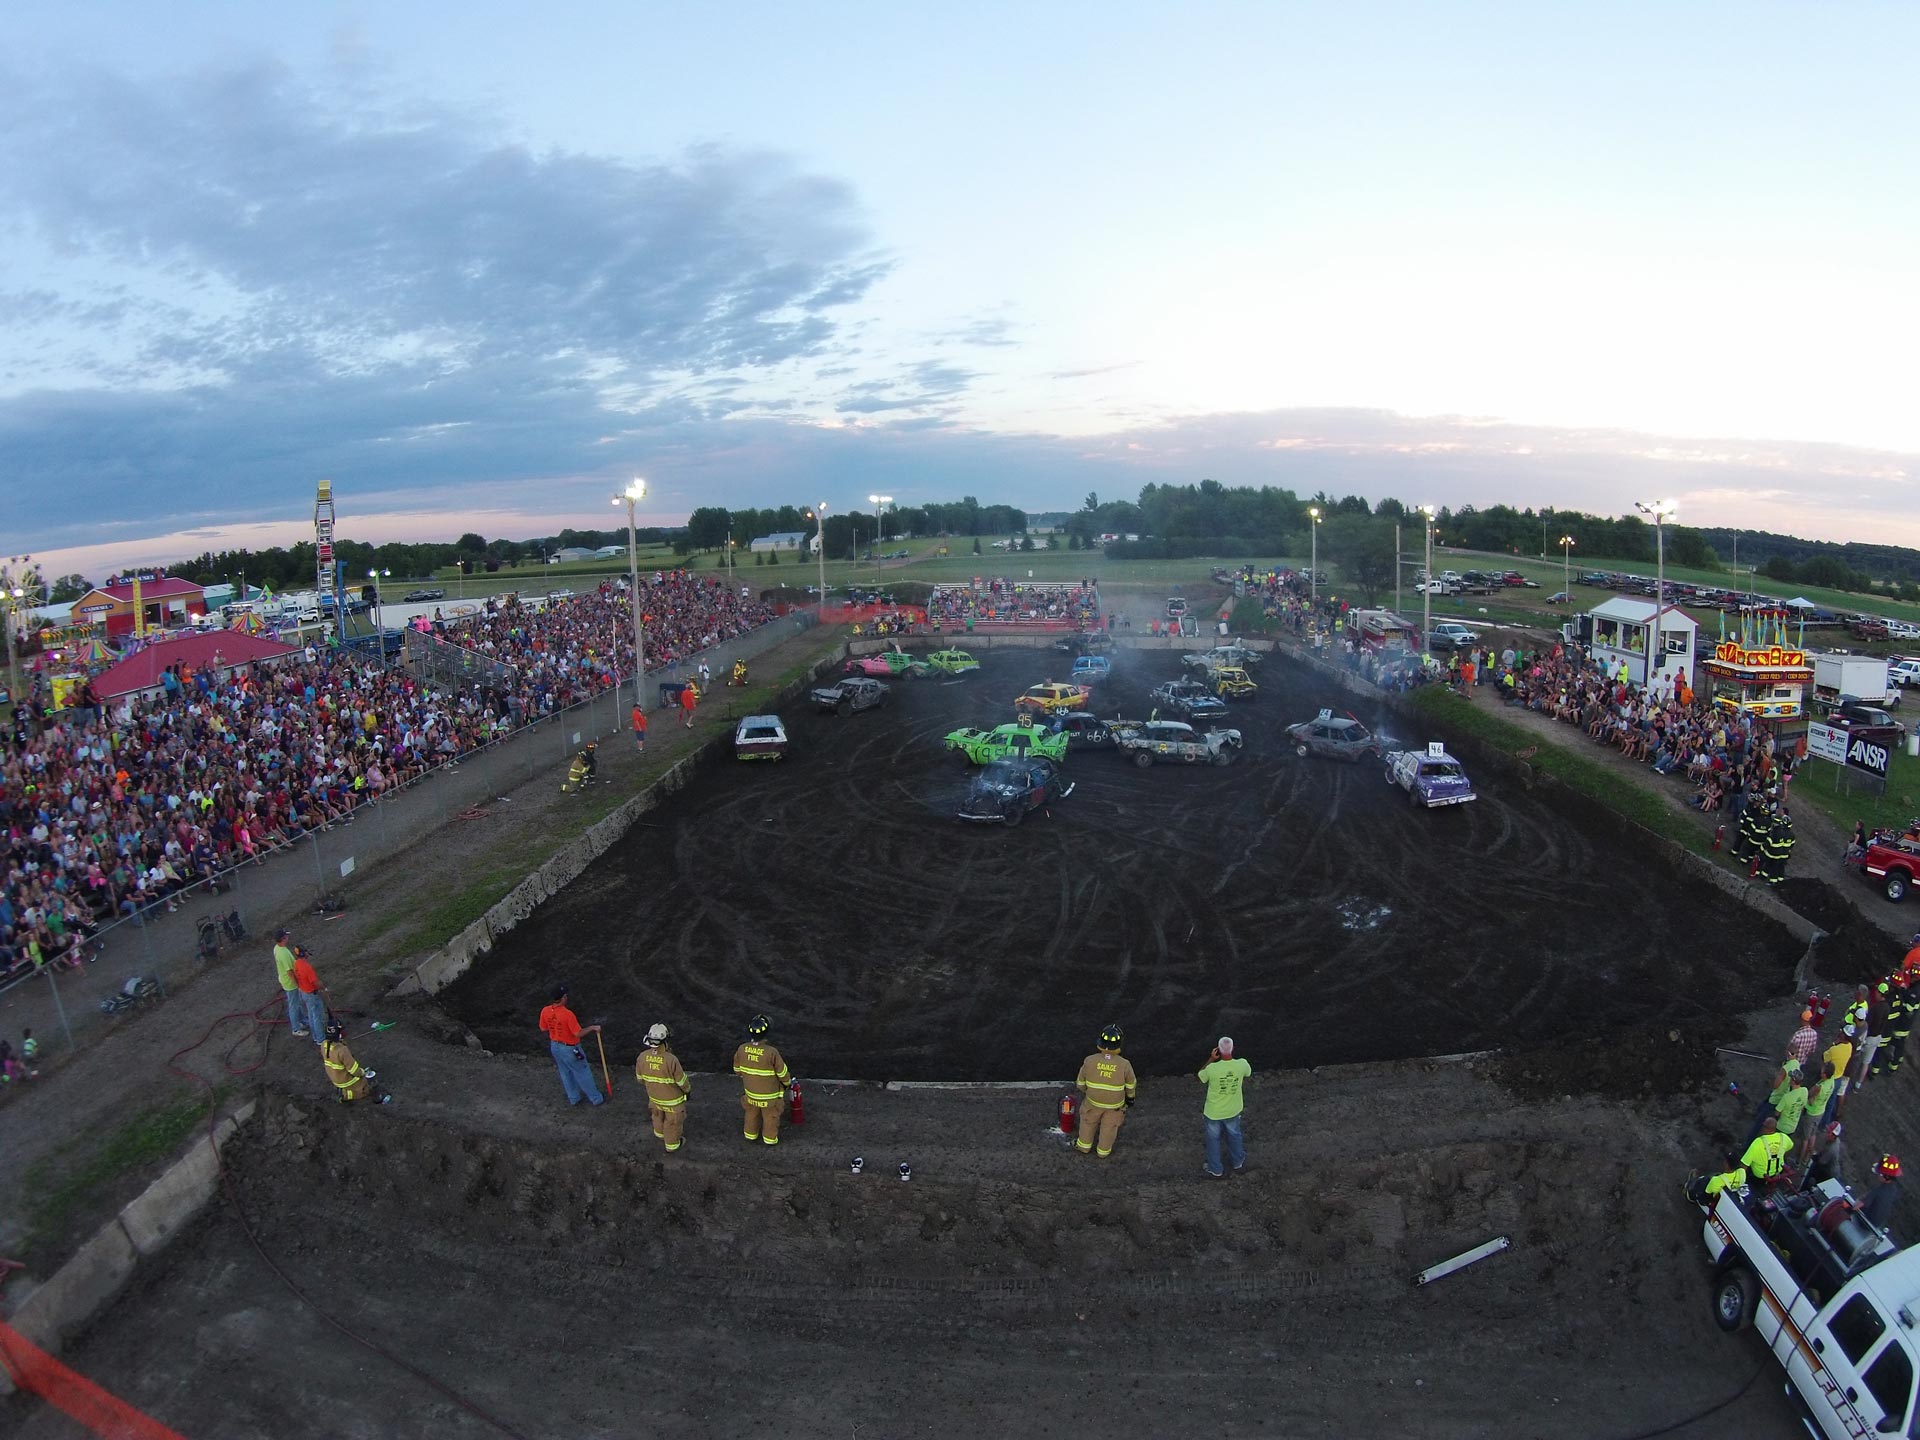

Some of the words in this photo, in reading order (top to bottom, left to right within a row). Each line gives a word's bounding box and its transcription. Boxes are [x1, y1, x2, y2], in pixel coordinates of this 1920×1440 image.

[1017, 714, 1033, 728] 95
[1086, 730, 1109, 743] 666
[1431, 744, 1442, 754] 46
[1847, 739, 1888, 772] ANSR
[744, 1046, 765, 1057] SAVAGE
[645, 1055, 664, 1065] SAVAGE
[747, 1054, 760, 1063] FIRE
[649, 1063, 661, 1071] FIRE
[1096, 1062, 1118, 1072] SAVAGE
[1100, 1070, 1113, 1079] FIRE
[1812, 1367, 1872, 1440] FIR
